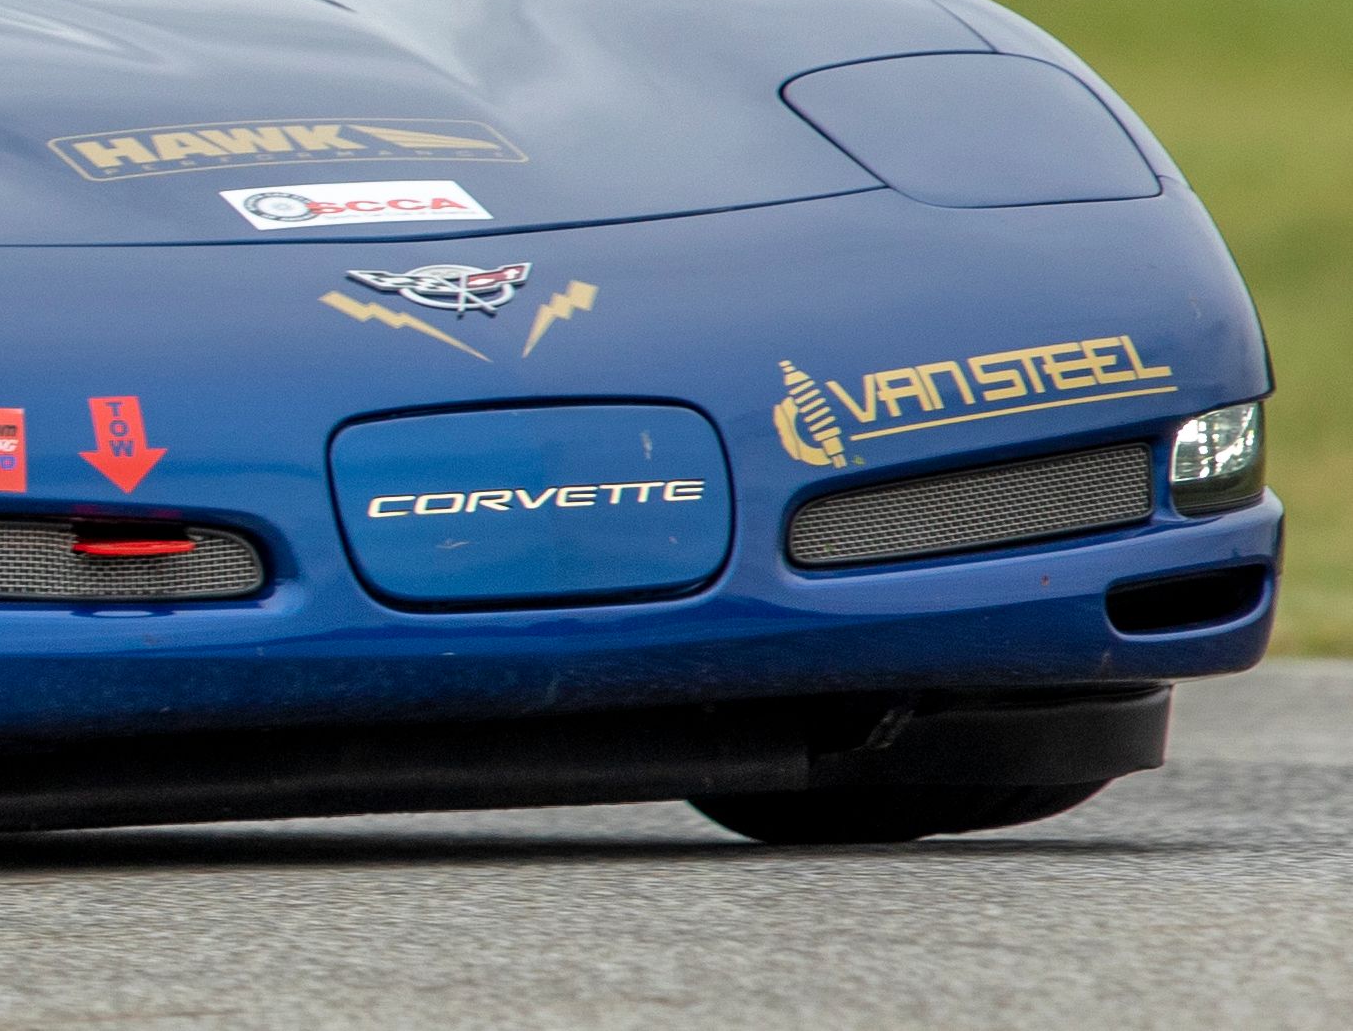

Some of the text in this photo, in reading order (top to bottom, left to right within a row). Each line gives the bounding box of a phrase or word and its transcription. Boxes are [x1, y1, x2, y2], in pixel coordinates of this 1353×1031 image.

[77, 124, 369, 167] HAWK
[305, 197, 469, 215] SCCA
[105, 402, 134, 458] TOW
[367, 479, 705, 518] CORVETTE
